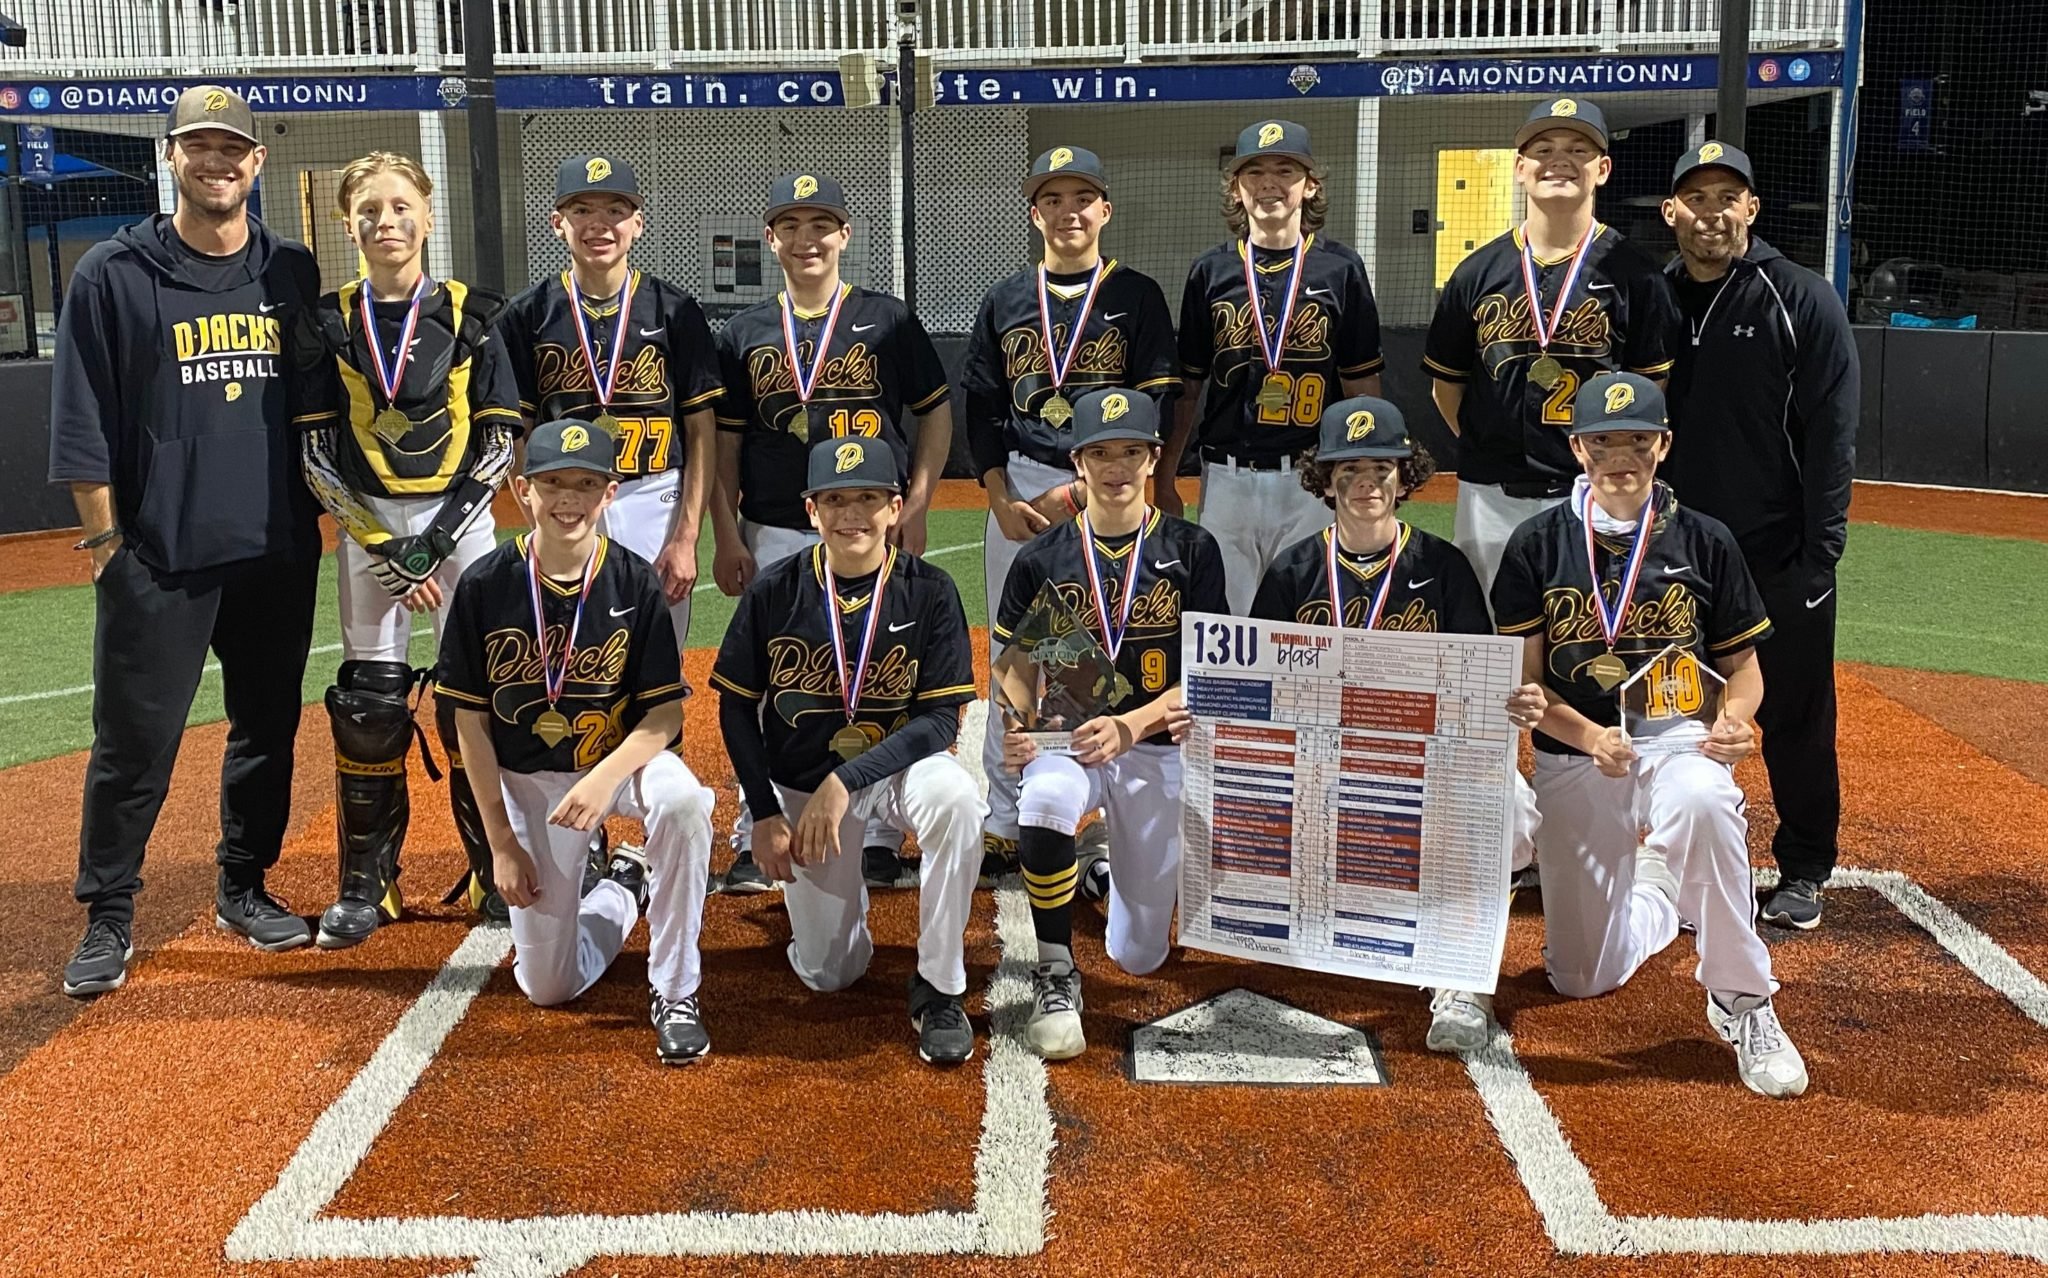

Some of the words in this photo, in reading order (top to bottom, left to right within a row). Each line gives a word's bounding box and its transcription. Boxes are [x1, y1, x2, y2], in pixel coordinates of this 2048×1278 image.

[600, 75, 747, 105] train.
[1052, 69, 1156, 98] win.
[1381, 63, 1692, 89] @DIAMONDNATIONNJ
[1905, 108, 1926, 117] FIELD
[1911, 121, 1920, 136] 4
[34, 153, 43, 168] 2
[181, 359, 279, 385] BASEBALL
[1257, 370, 1326, 427] 28
[1542, 369, 1596, 425] 2
[829, 409, 882, 440] 12
[616, 417, 673, 473] 77
[1194, 621, 1257, 666] 13U
[1270, 632, 1312, 647] MEMORIAL
[1316, 637, 1332, 648] DAY
[1030, 651, 1079, 664] NATION
[1141, 648, 1166, 693] 9
[1277, 642, 1328, 672] blast
[1644, 655, 1704, 721] 10
[336, 759, 396, 774] ASTON
